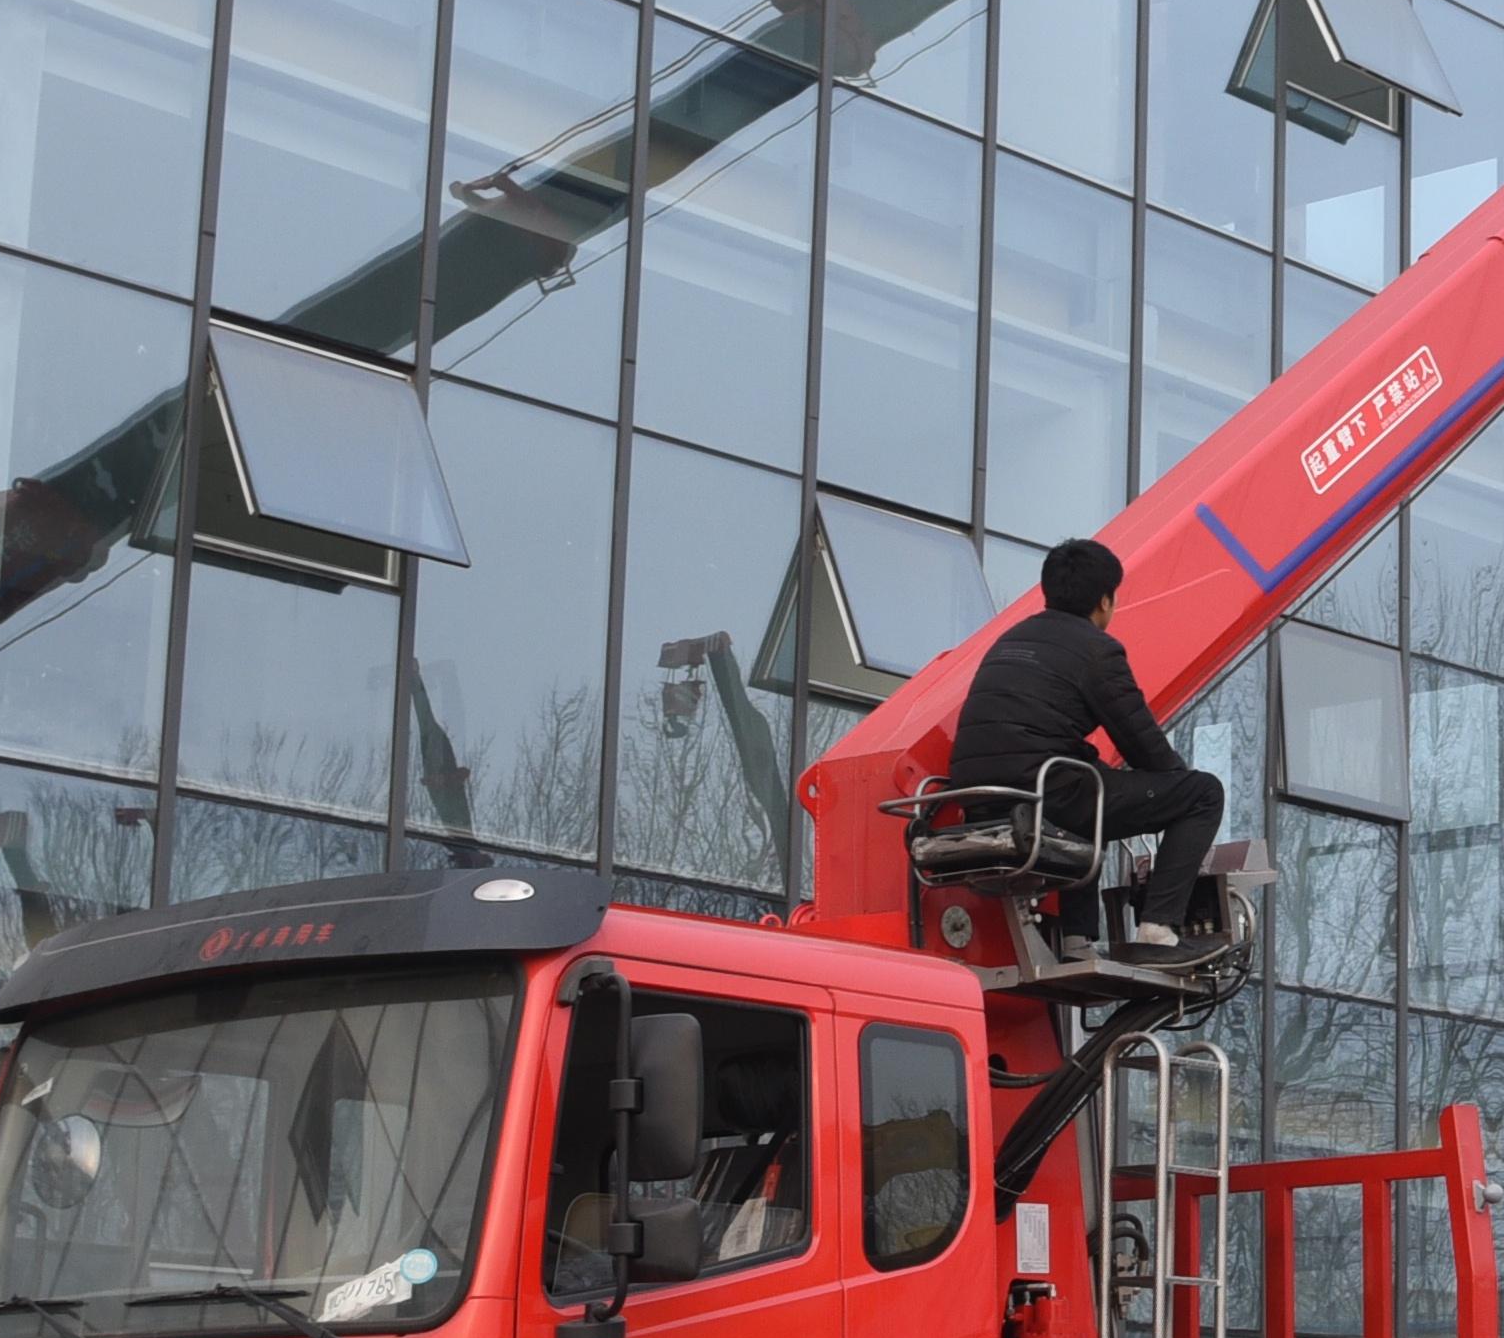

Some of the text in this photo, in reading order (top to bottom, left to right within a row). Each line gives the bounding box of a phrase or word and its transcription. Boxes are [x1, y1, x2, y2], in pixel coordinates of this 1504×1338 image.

[1308, 412, 1366, 478] 起重臂下
[1372, 358, 1433, 420] 严禁站人
